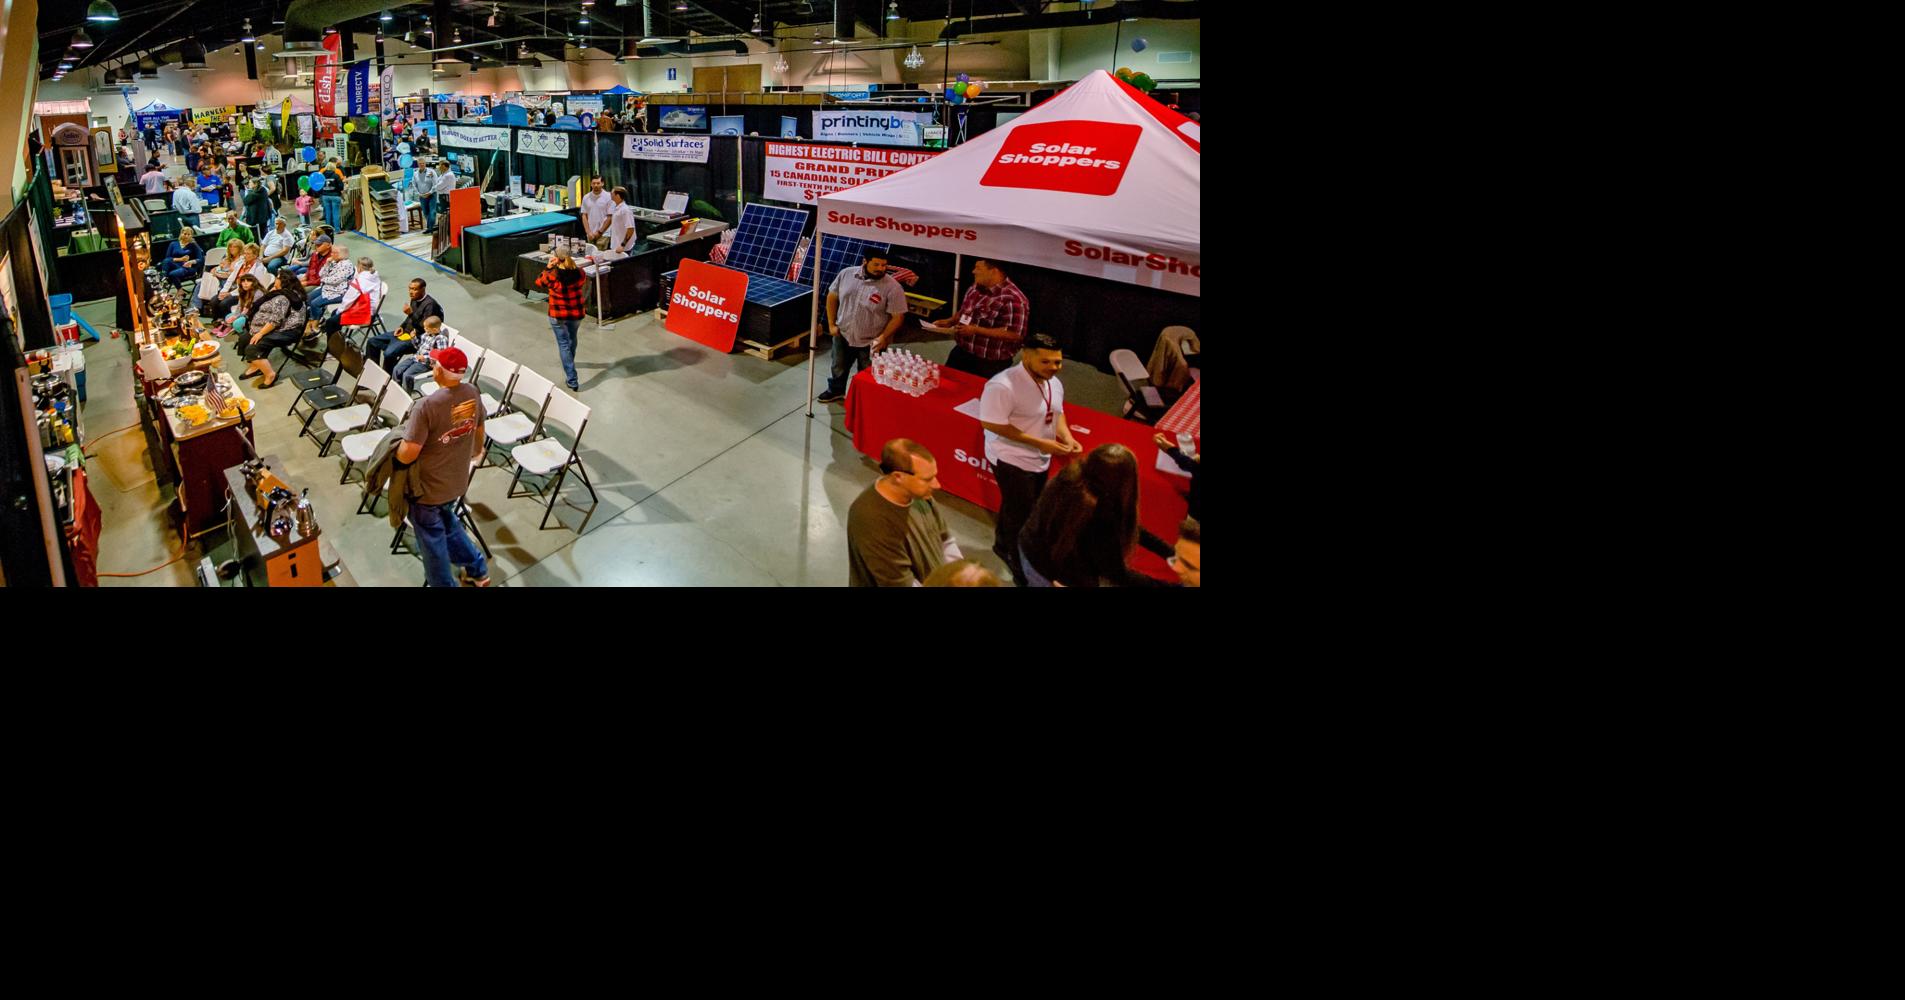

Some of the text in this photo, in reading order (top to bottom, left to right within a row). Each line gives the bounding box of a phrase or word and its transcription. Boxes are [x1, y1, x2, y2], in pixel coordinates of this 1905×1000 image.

[318, 75, 332, 103] dish
[194, 107, 227, 118] HARNESS
[643, 137, 664, 147] Solid
[665, 138, 704, 149] Surfaces
[1029, 142, 1097, 155] Solar
[768, 144, 810, 157] HIGHEST
[811, 145, 861, 161] ELECTRIC
[863, 150, 887, 164] BILL
[998, 153, 1121, 170] Shoppers
[770, 169, 876, 186] 15 CANADIAN SOLA
[794, 161, 902, 178] GRAND PRIZ
[827, 210, 978, 242] SolarShoppers
[688, 285, 726, 306] Solar
[672, 292, 738, 323] Shoppers
